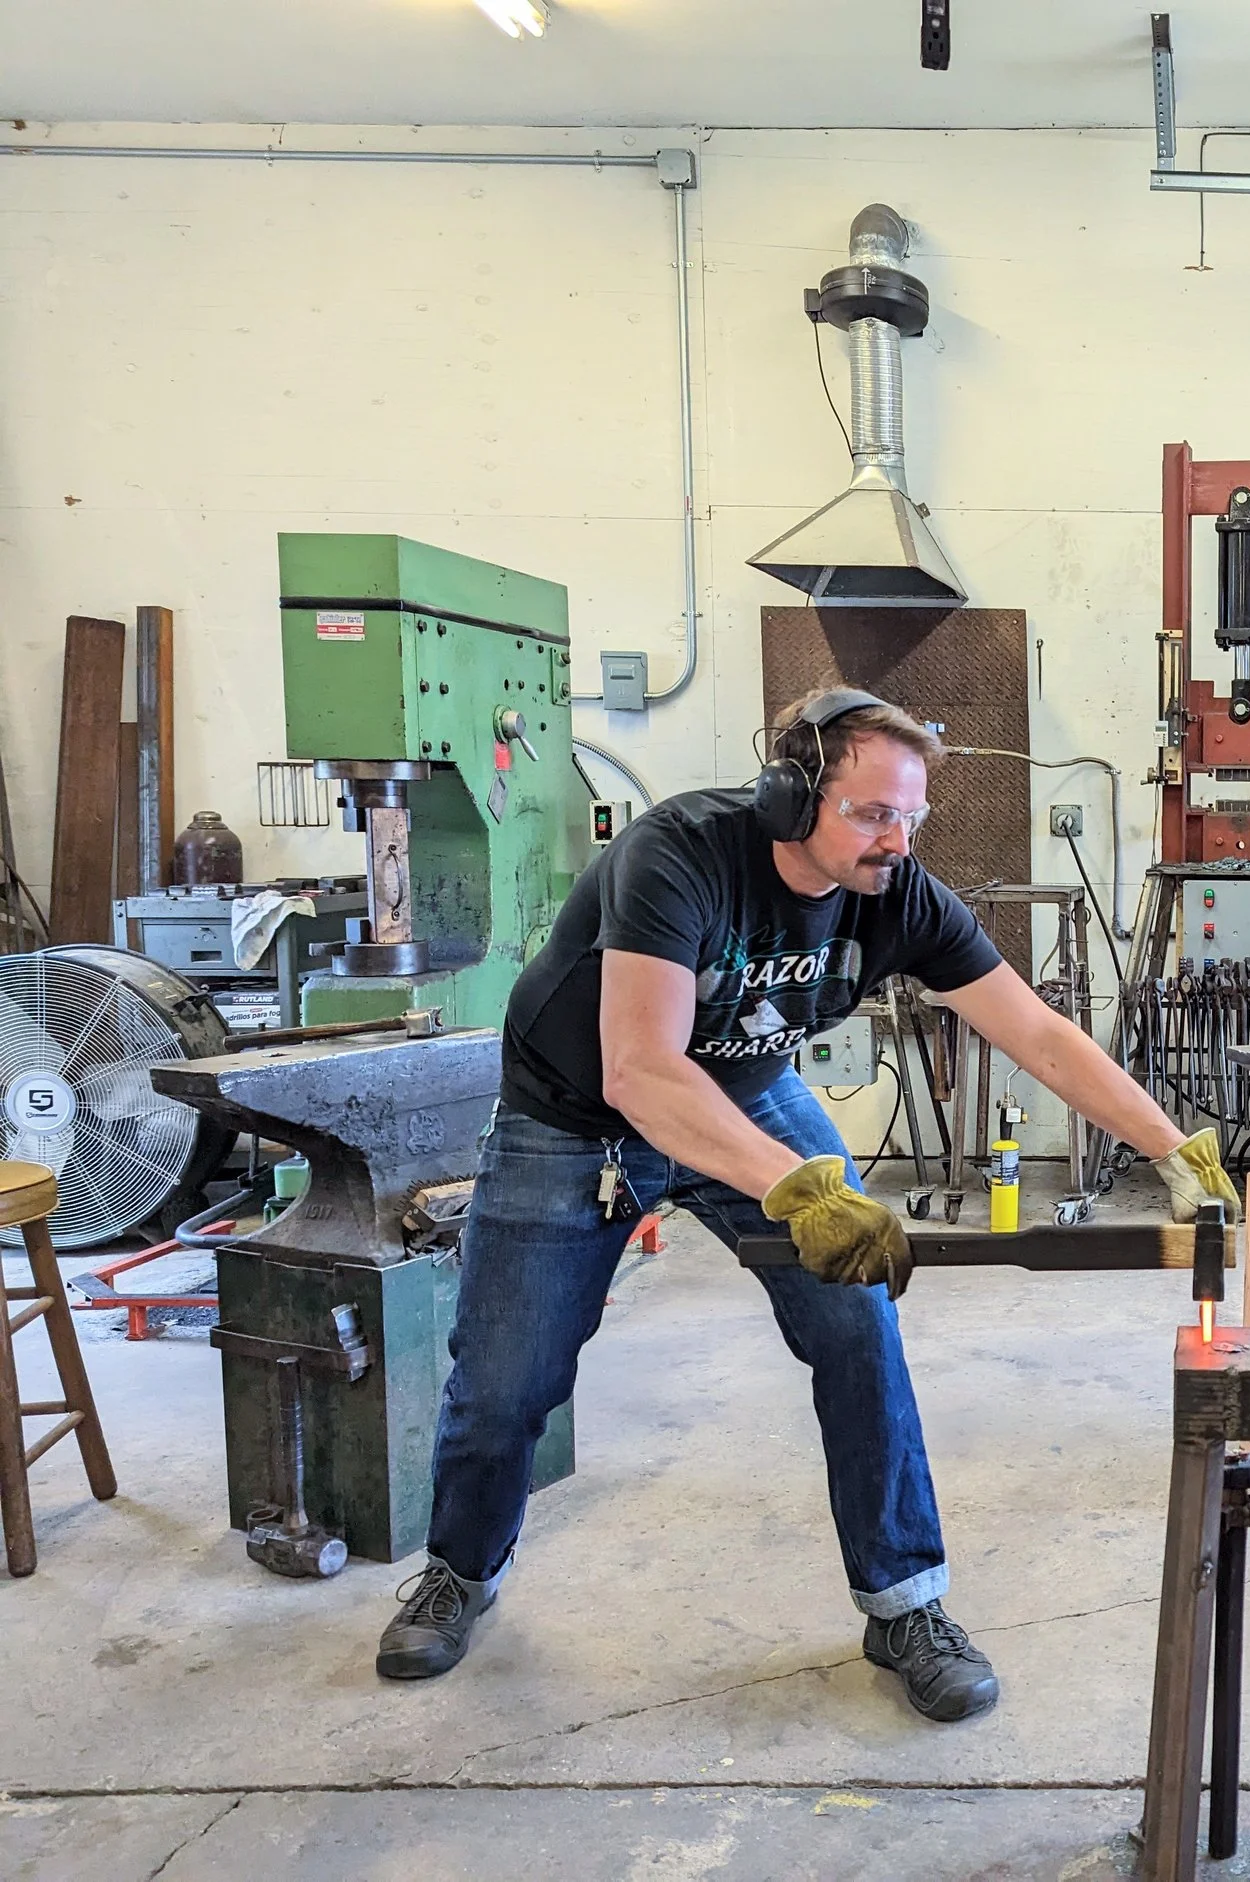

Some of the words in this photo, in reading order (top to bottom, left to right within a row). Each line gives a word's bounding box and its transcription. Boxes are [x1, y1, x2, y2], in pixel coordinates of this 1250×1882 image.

[737, 946, 830, 997] RAZOR
[225, 1013, 251, 1021] adrillos
[252, 1012, 267, 1020] para
[269, 1010, 281, 1018] fog
